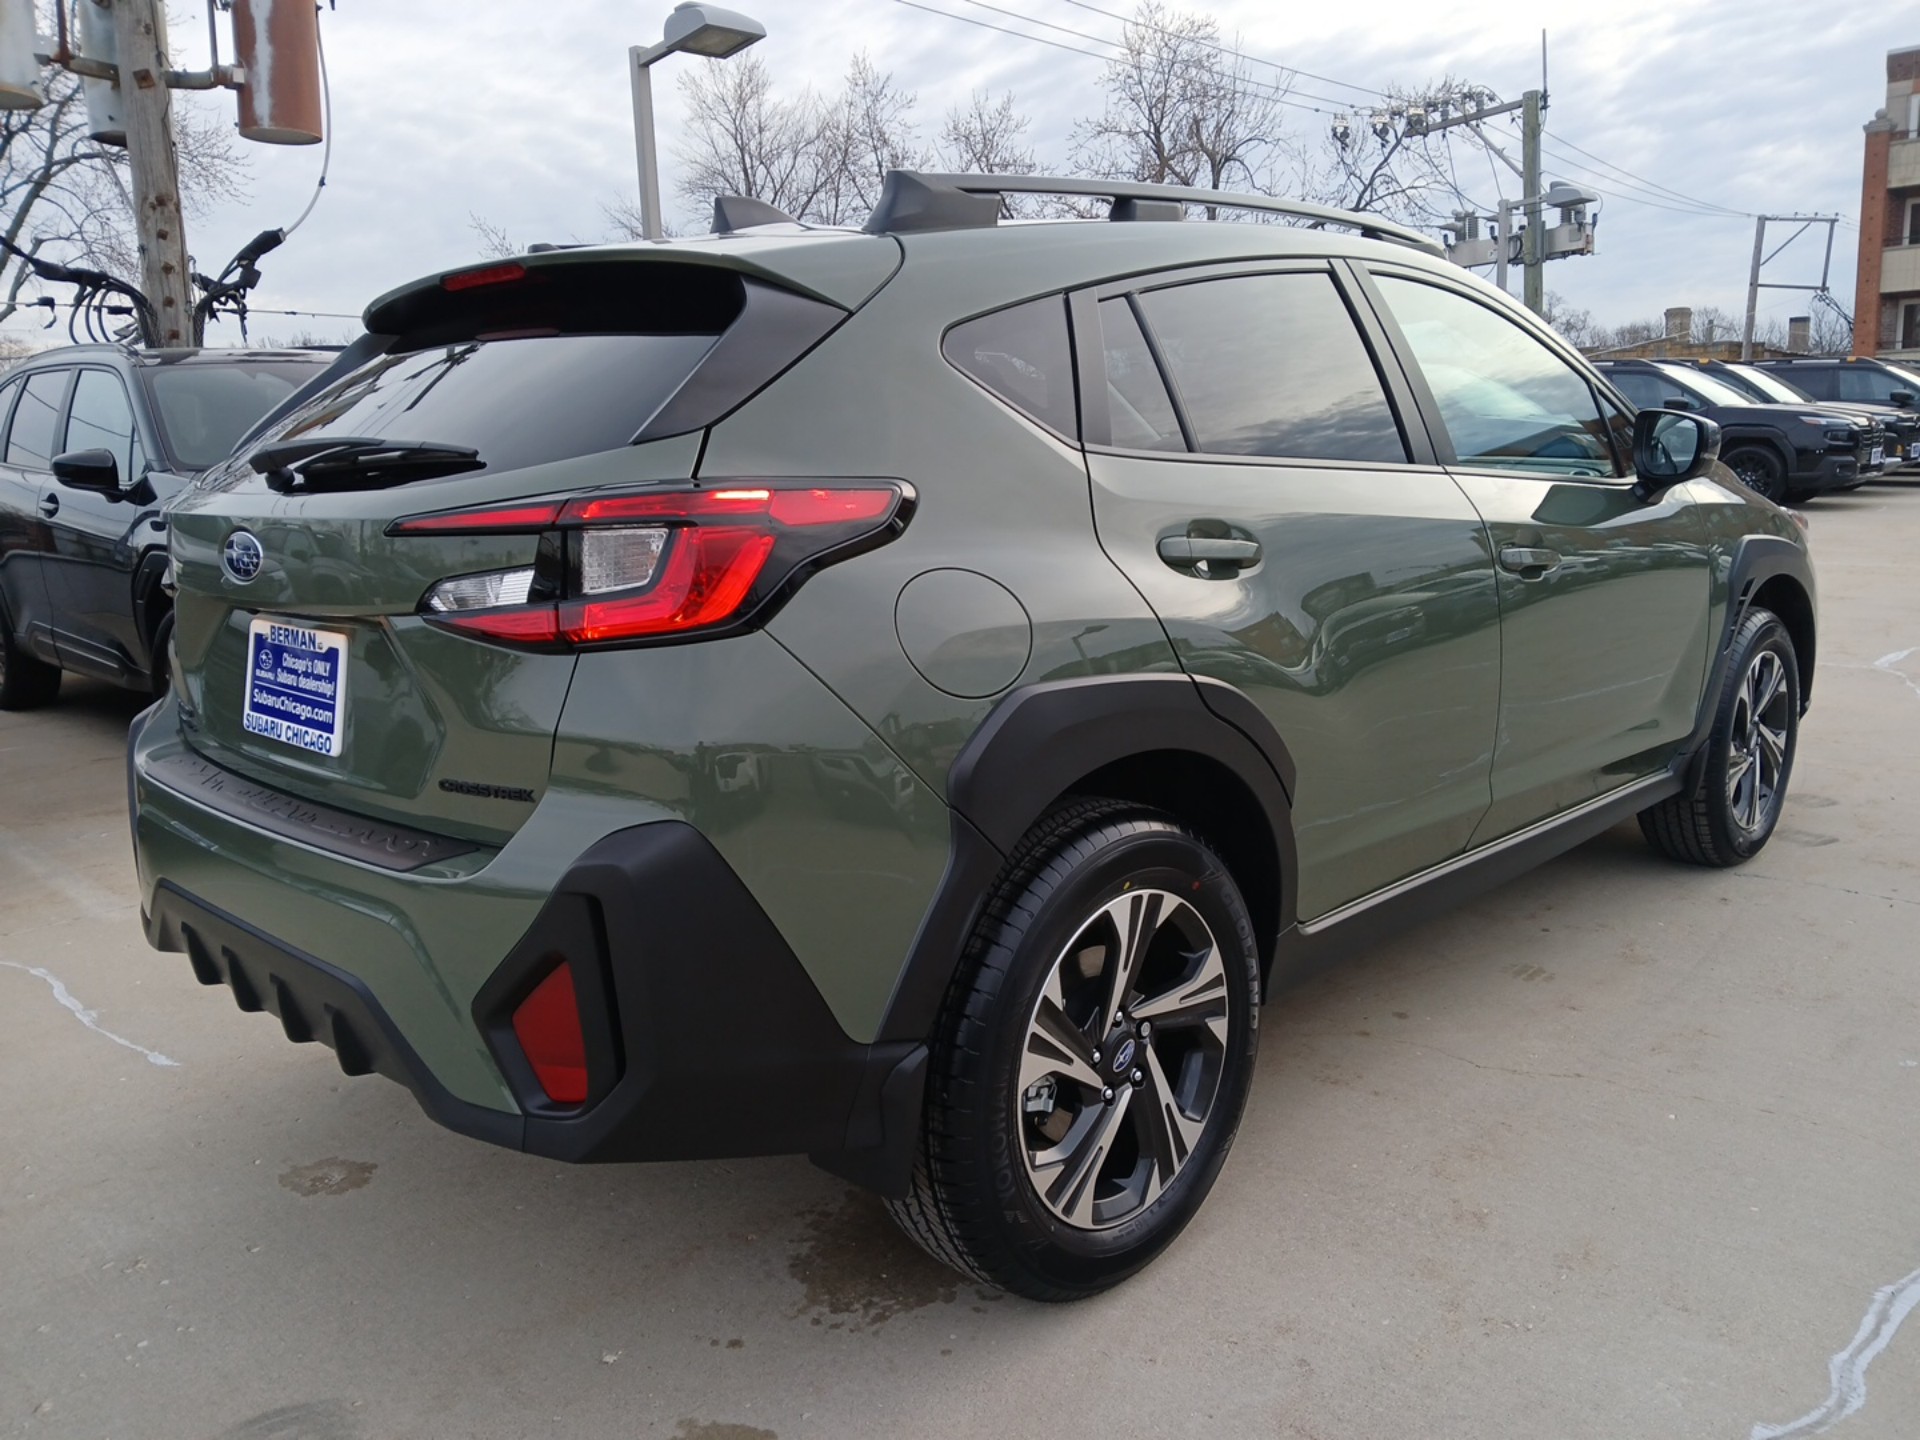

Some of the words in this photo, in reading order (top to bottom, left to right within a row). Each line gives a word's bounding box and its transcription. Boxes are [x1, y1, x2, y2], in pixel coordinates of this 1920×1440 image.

[270, 625, 316, 650] BERMAN
[283, 653, 312, 673] Chicago's
[312, 659, 331, 677] ONLY
[277, 668, 297, 686] Subaru
[299, 675, 334, 697] dealership!
[253, 689, 332, 724] SubaruChicago.com
[245, 713, 282, 738] SUBARU
[285, 725, 332, 753] CHICAGO
[438, 778, 536, 803] CROSSTREK
[1220, 885, 1259, 1058] GEOLANDA
